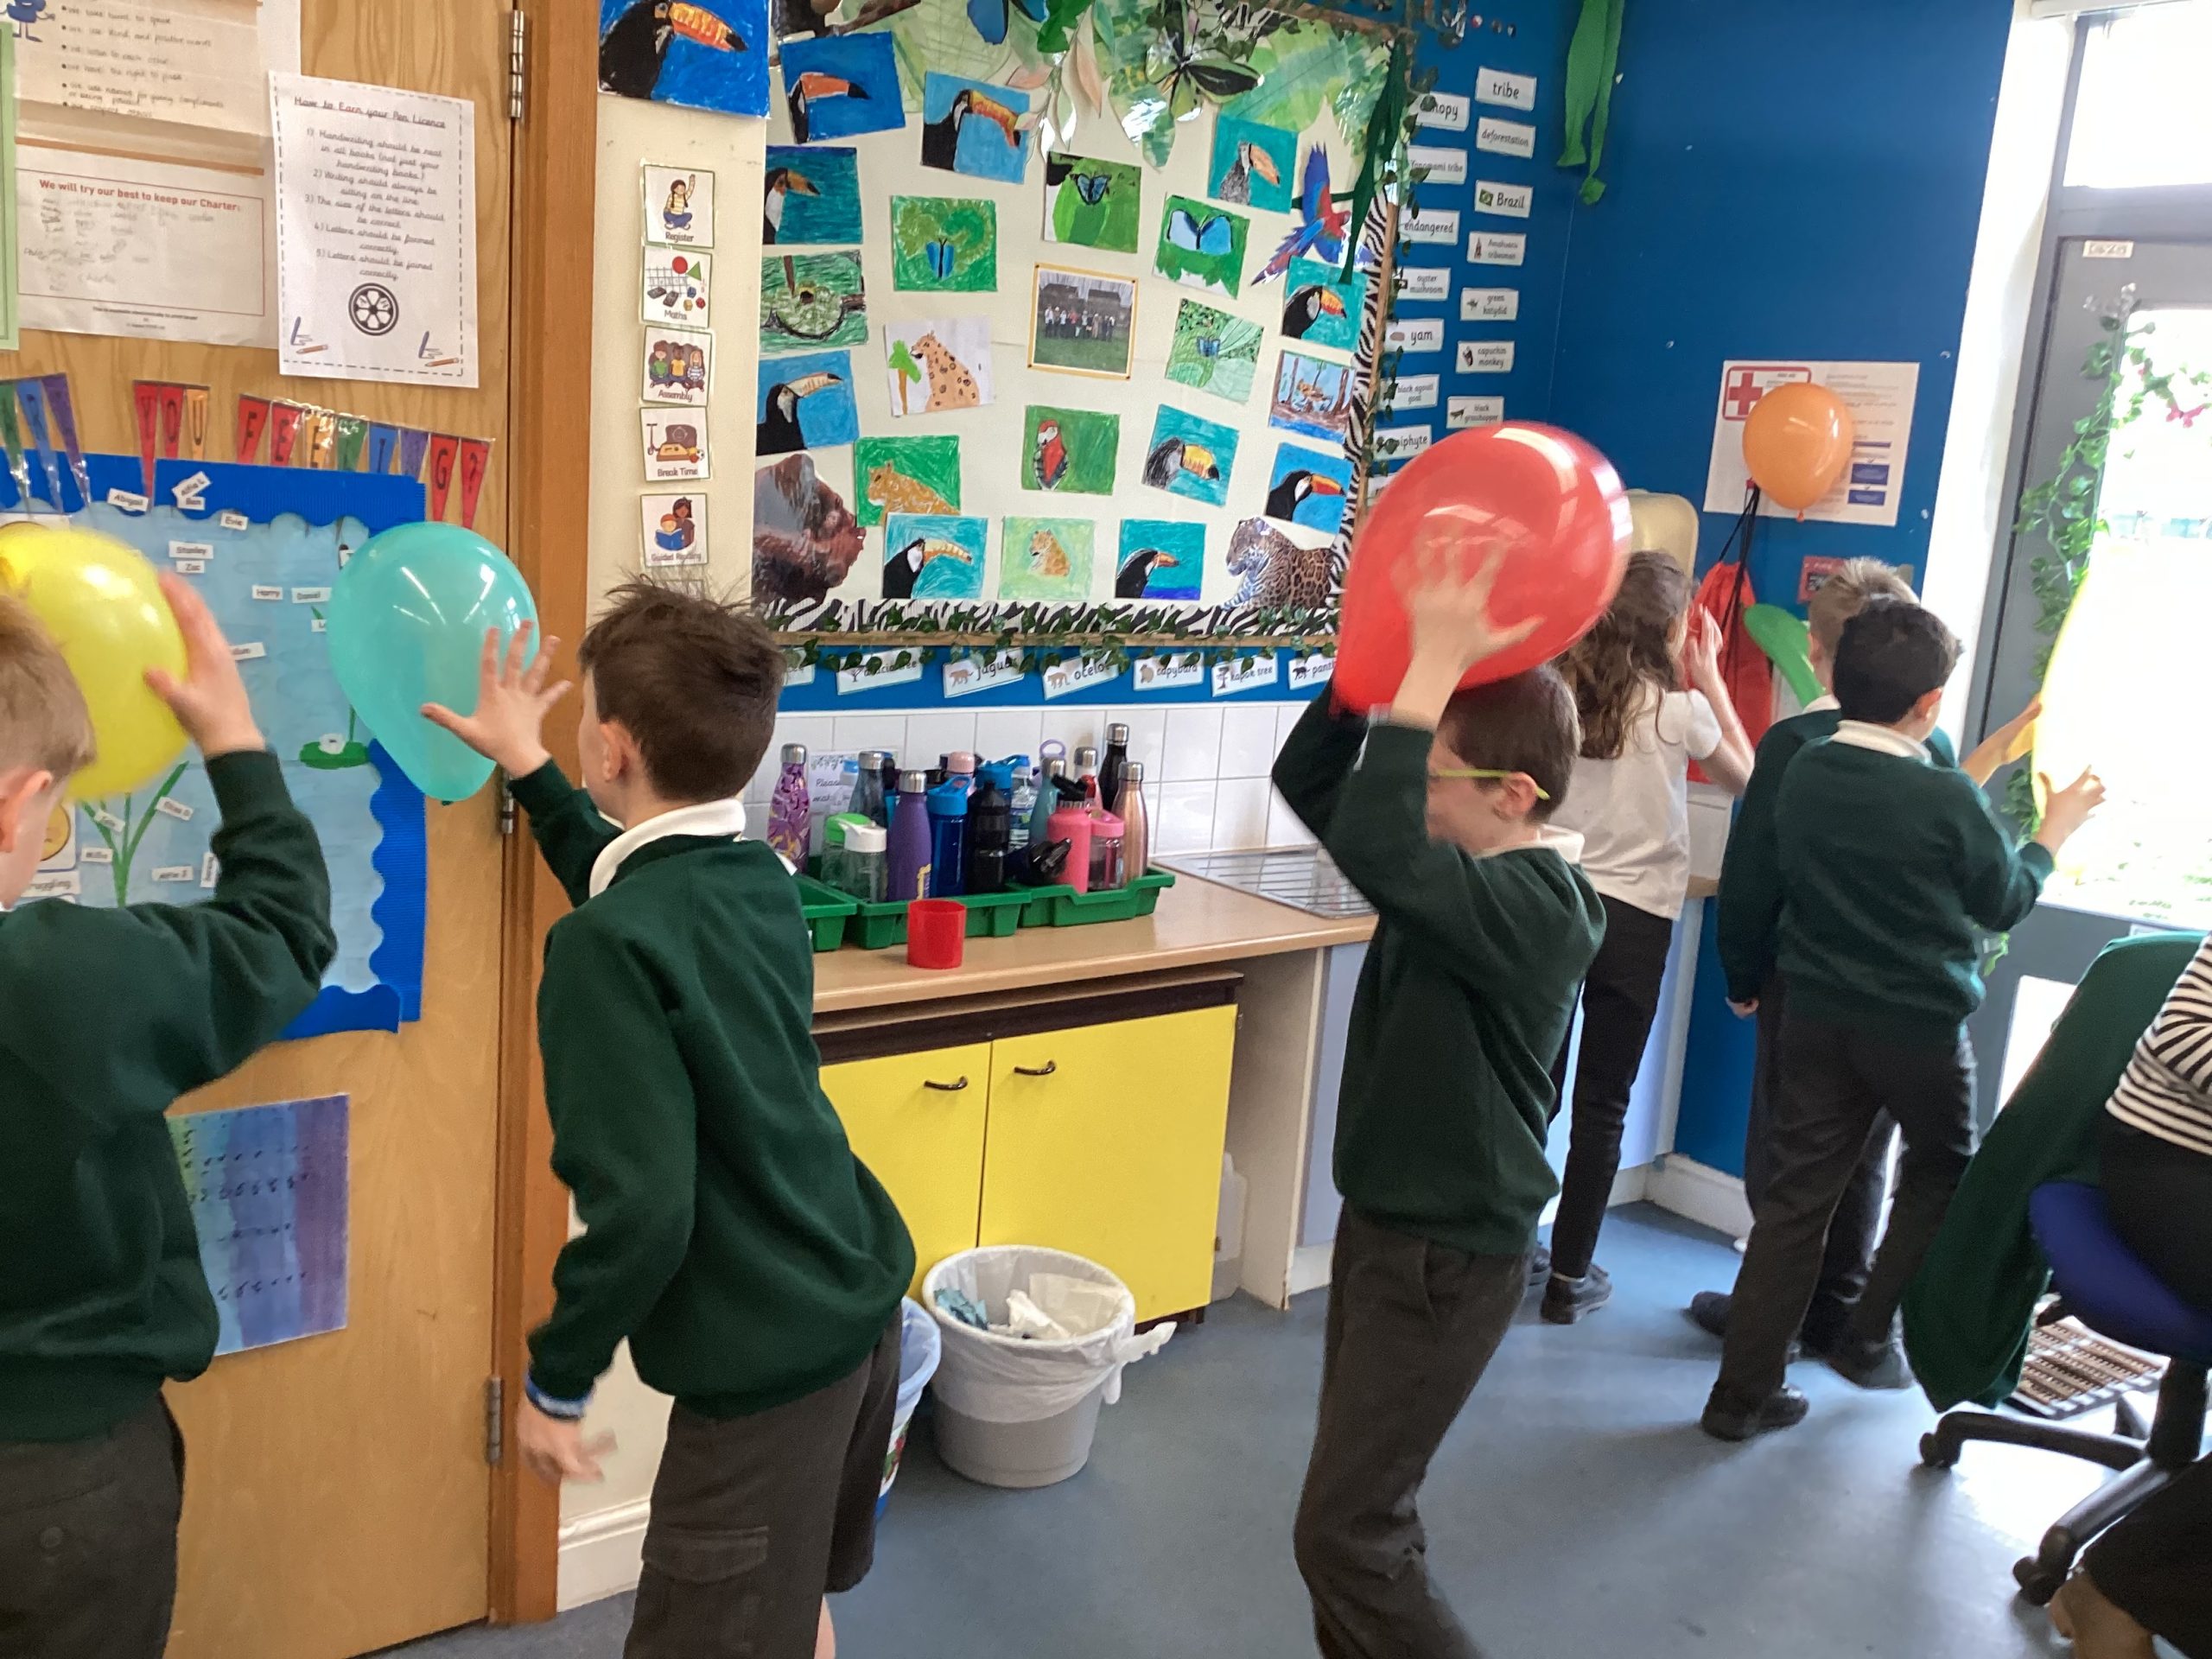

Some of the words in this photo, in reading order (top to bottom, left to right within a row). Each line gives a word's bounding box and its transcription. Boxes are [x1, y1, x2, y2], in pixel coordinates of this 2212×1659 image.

[1492, 82, 1520, 99] tribe
[294, 96, 317, 107] How
[323, 100, 334, 109] to
[339, 102, 363, 114] Earn
[366, 109, 387, 118] your
[412, 112, 446, 129] Licence
[1482, 129, 1529, 146] deforestation
[377, 140, 407, 151] should
[410, 145, 421, 154] be
[1447, 162, 1464, 172] tribe
[358, 176, 388, 188] should
[39, 179, 55, 190] We
[58, 181, 77, 193] will
[80, 184, 95, 196] try
[98, 188, 115, 197] our
[118, 188, 139, 200] best
[141, 191, 152, 201] to
[154, 193, 178, 206] keep
[181, 197, 198, 207] our
[1496, 192, 1525, 208] Brazil
[414, 210, 445, 222] should
[357, 228, 388, 240] should
[1404, 220, 1454, 236] endangered
[665, 232, 694, 244] Register
[359, 255, 390, 266] should
[1417, 275, 1437, 286] oyster
[1409, 284, 1444, 294] mushroom
[1487, 295, 1505, 304] green
[664, 309, 687, 321] Maths
[1410, 330, 1433, 346] yam
[1478, 346, 1507, 357] capuchin
[1478, 358, 1504, 369] monkey
[658, 390, 693, 403] Assembly
[658, 468, 678, 477] Break
[680, 467, 698, 476] Time
[1257, 666, 1273, 676] tree
